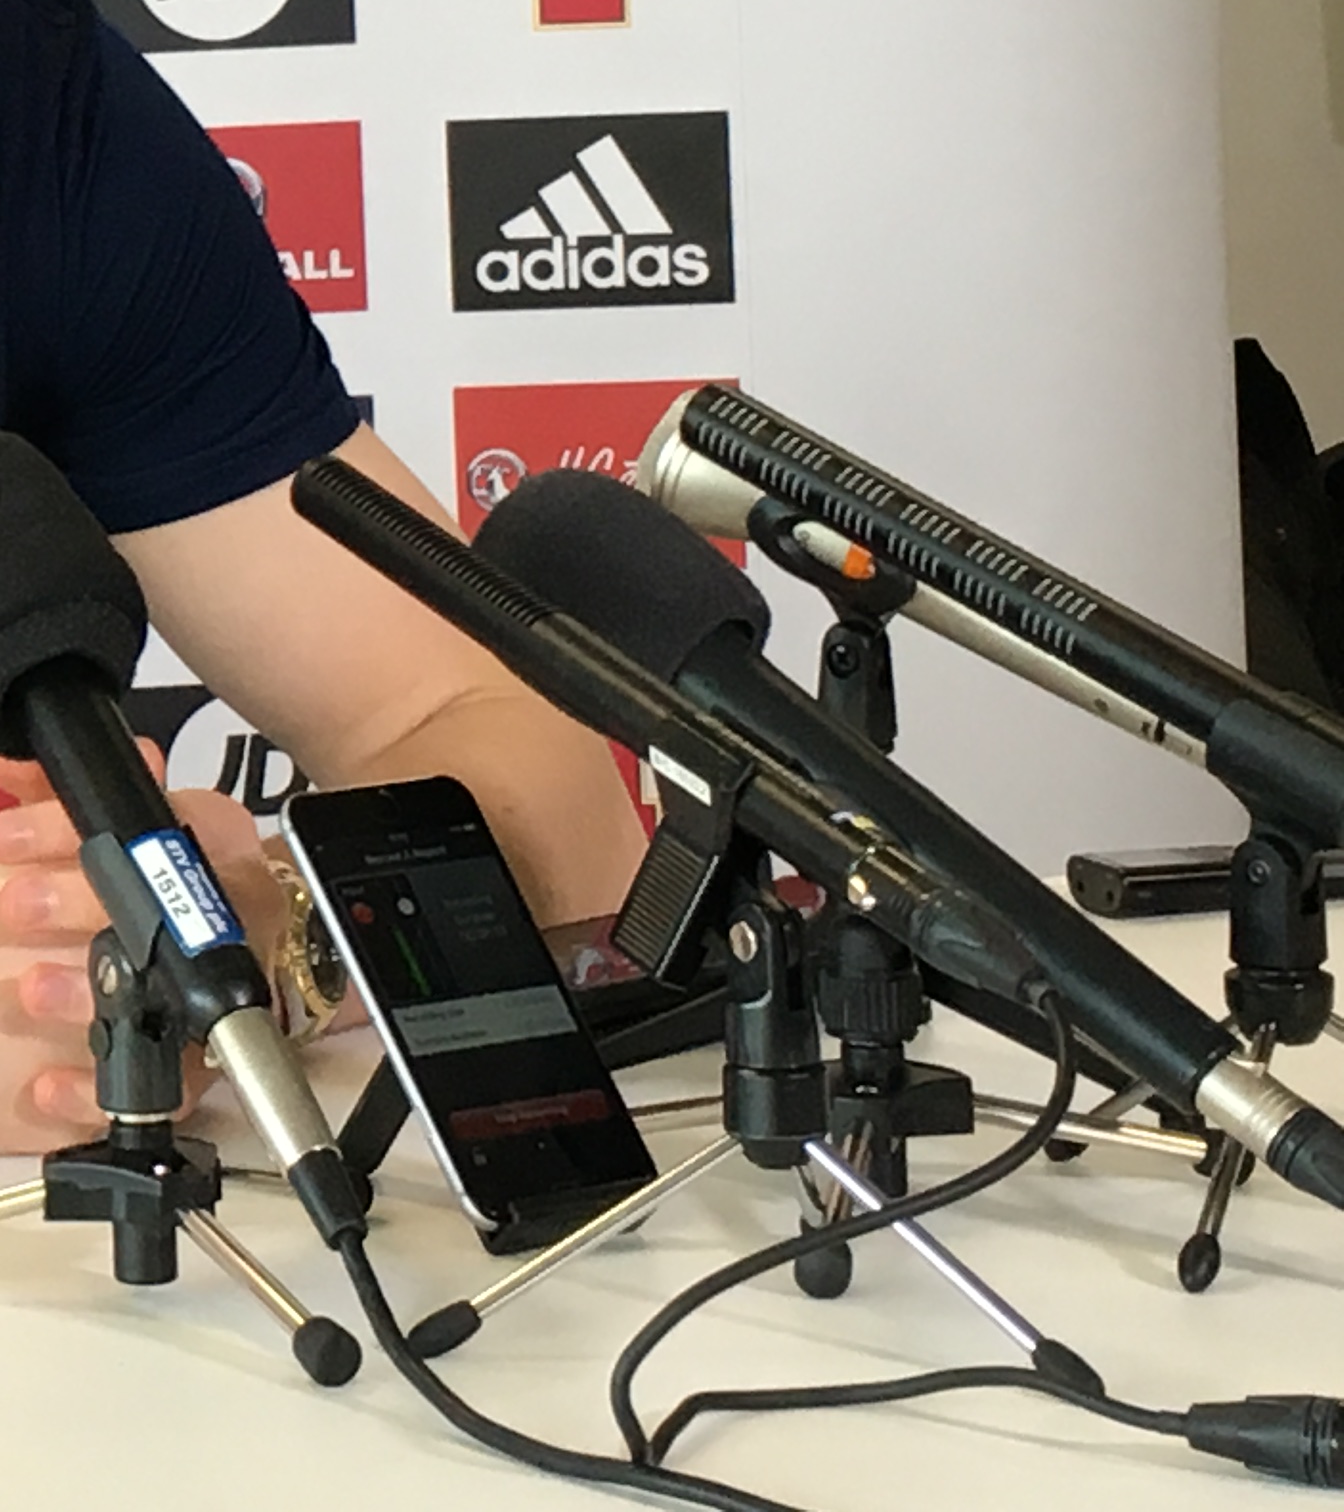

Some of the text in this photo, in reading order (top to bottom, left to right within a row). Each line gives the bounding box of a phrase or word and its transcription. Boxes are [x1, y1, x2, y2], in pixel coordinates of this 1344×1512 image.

[476, 234, 710, 293] adidas
[214, 733, 309, 815] JD
[153, 868, 191, 918] 1512
